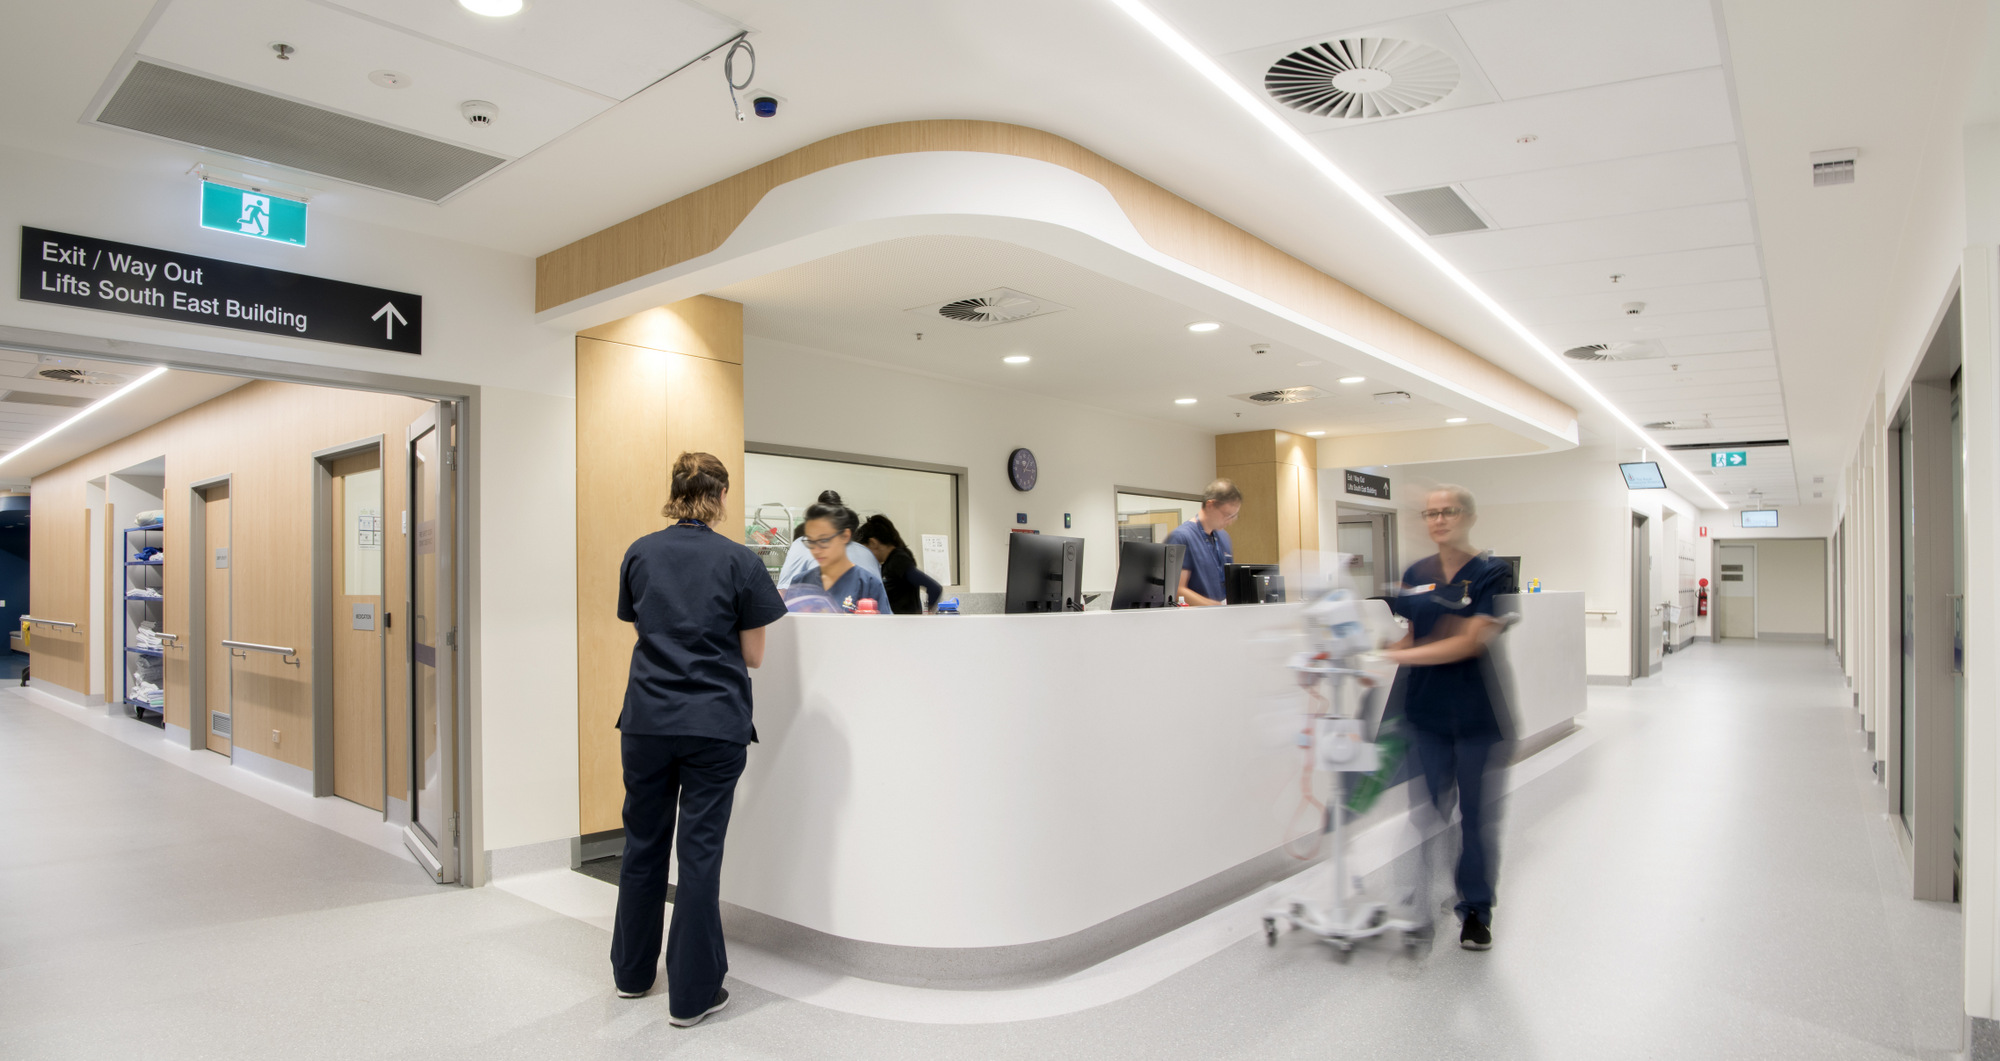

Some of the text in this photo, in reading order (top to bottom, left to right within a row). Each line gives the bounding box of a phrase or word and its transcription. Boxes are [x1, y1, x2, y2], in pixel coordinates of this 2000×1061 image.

[42, 240, 203, 286] Exit / Way Out
[41, 270, 307, 333] Lifts South East Building
